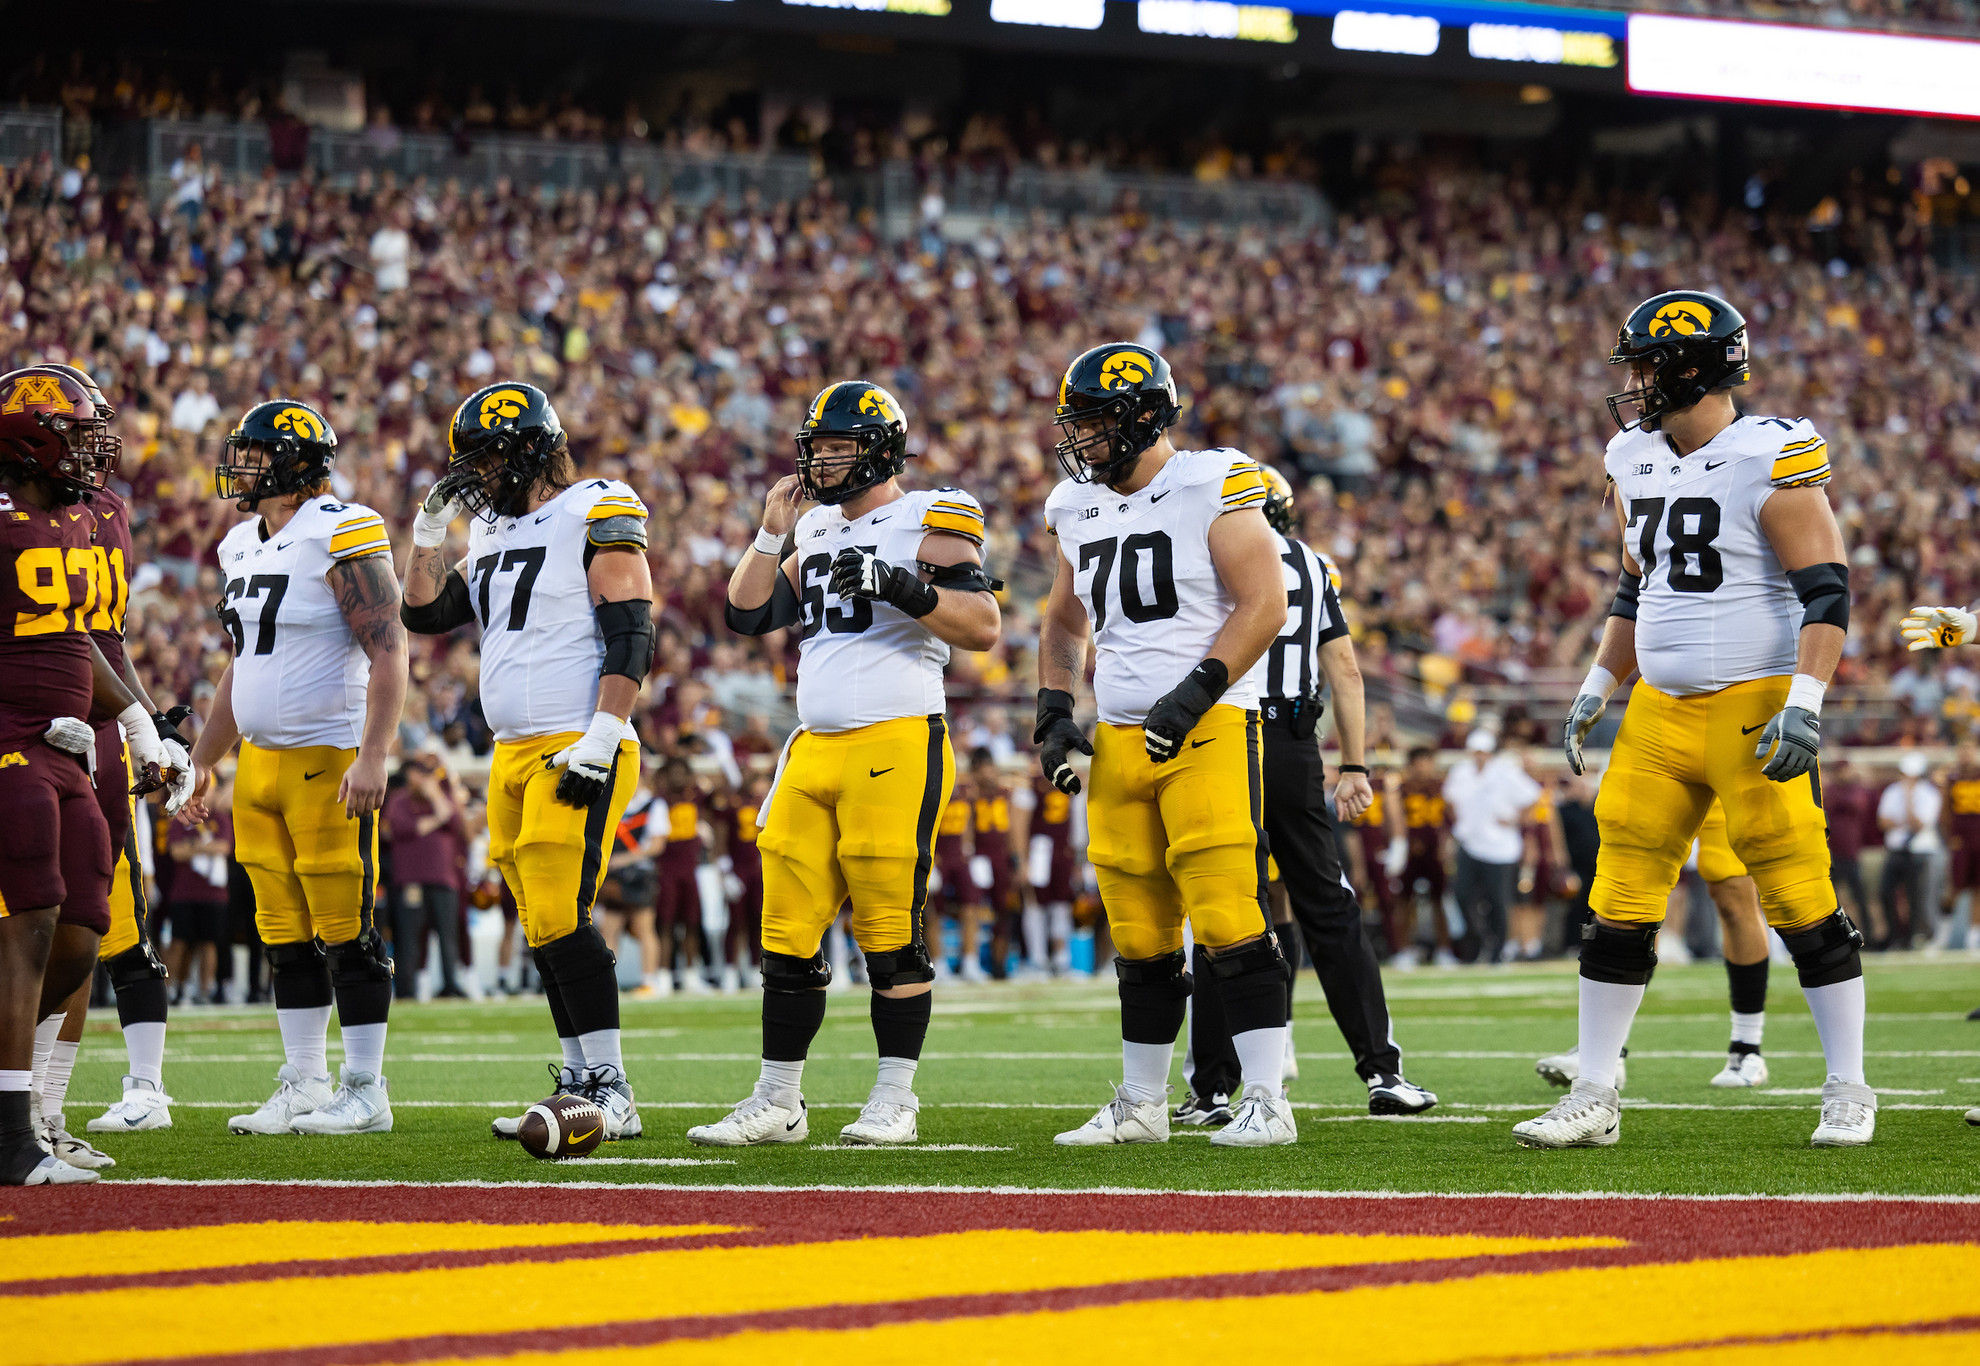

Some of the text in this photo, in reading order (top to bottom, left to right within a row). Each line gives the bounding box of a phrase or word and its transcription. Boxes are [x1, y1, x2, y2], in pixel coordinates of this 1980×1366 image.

[2, 376, 74, 415] M
[1079, 530, 1179, 633] 70
[1627, 497, 1724, 593] 78
[14, 547, 97, 637] 97
[222, 574, 290, 658] 67
[471, 546, 546, 631] 77
[1267, 706, 1278, 719] S
[0, 751, 29, 768] M
